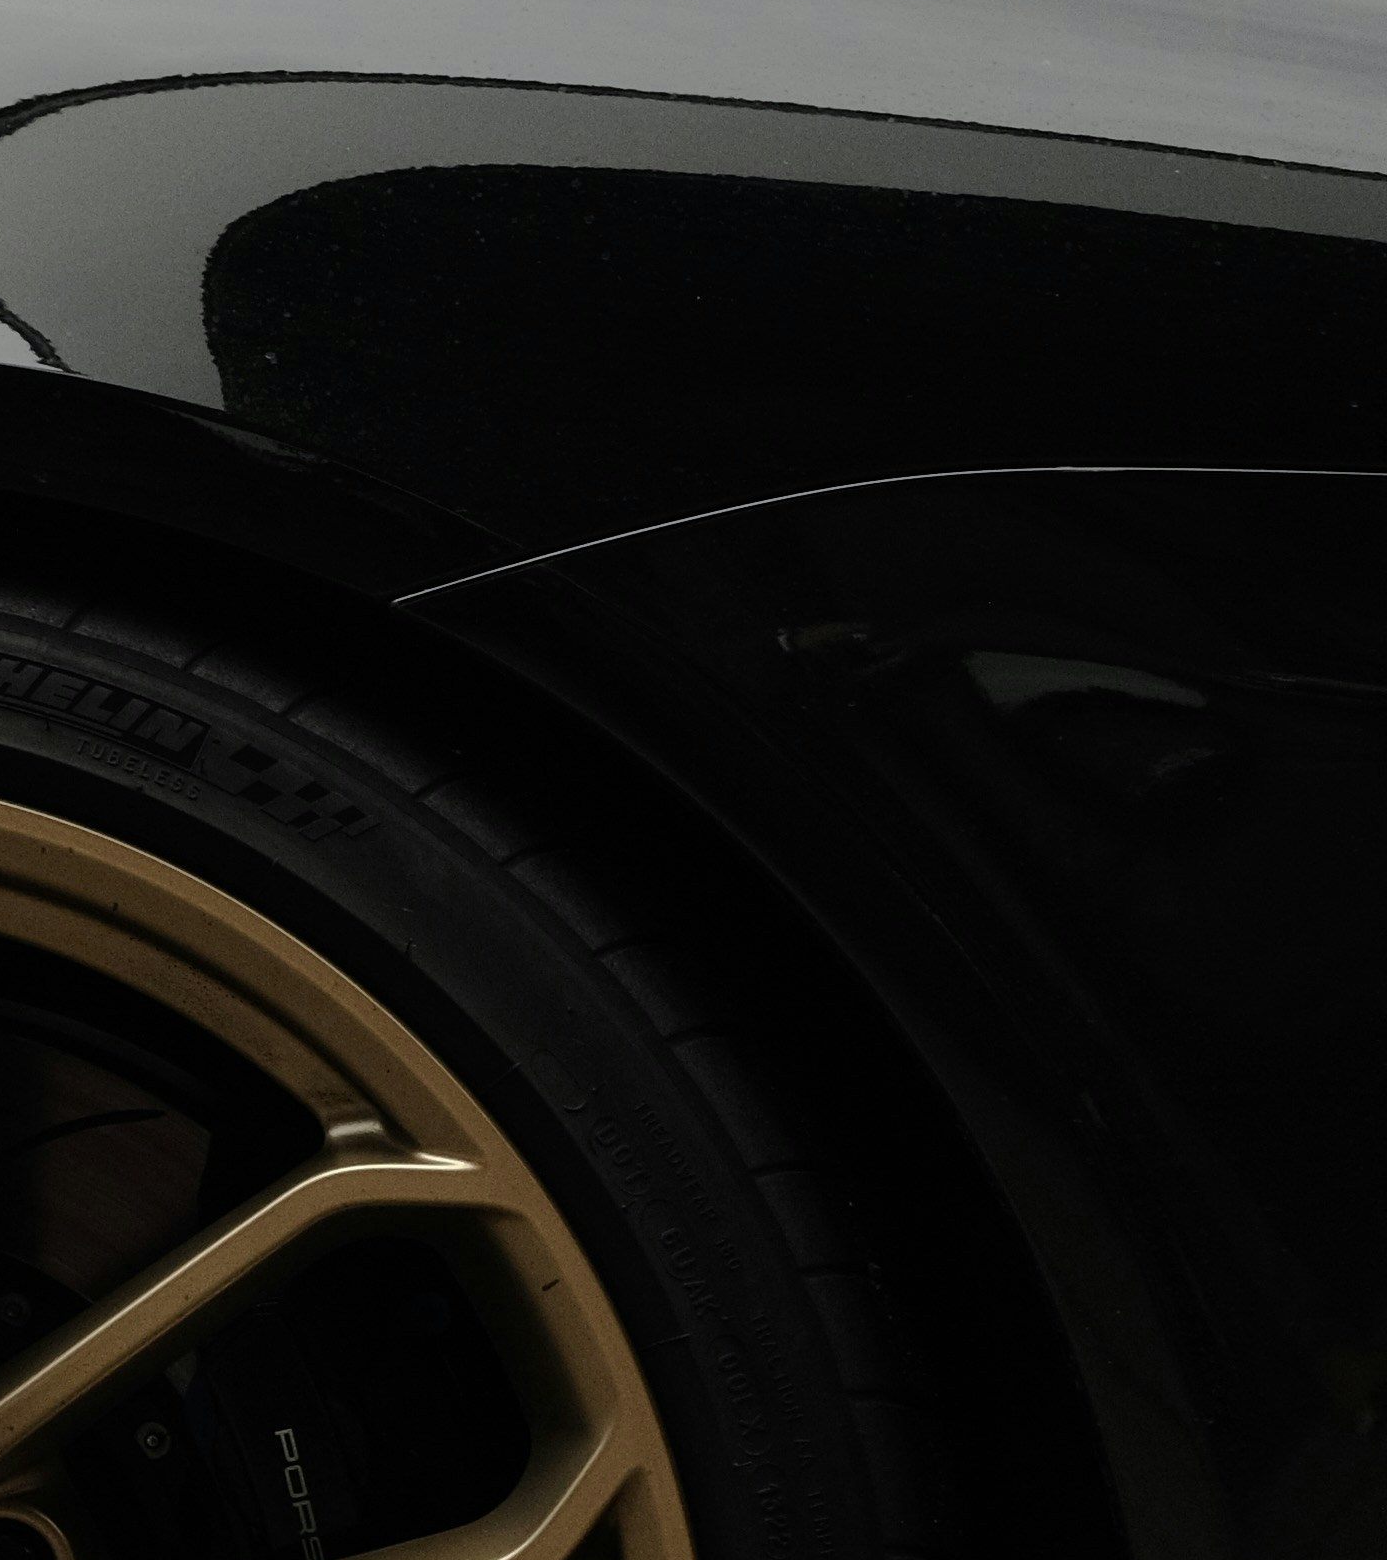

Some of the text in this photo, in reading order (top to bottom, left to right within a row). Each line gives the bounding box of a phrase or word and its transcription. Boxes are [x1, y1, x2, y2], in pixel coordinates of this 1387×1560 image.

[75, 737, 203, 801] TUBELESS
[629, 1093, 722, 1228] TREADWEAR
[745, 1306, 807, 1426] TRACTION
